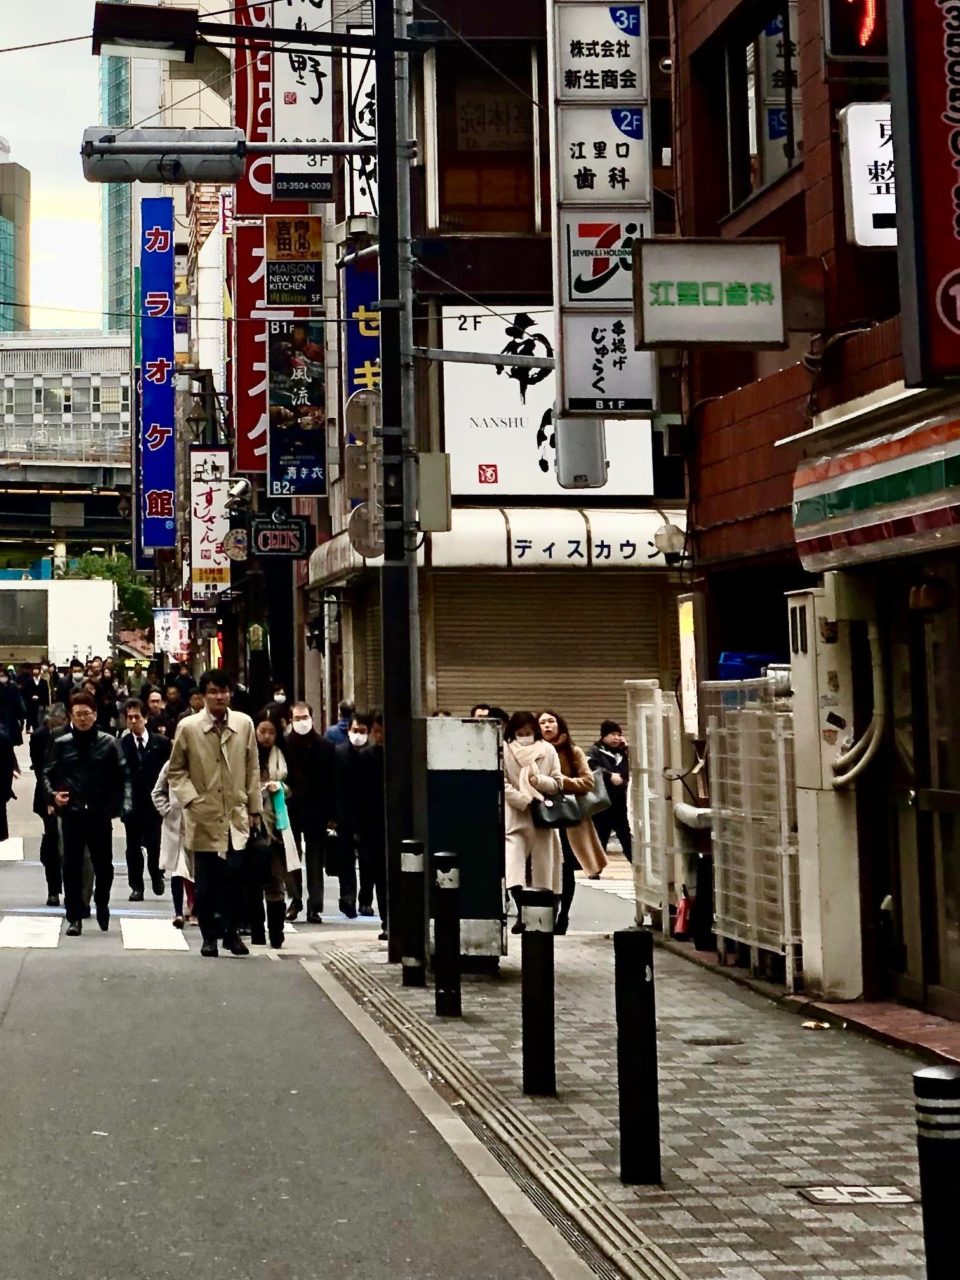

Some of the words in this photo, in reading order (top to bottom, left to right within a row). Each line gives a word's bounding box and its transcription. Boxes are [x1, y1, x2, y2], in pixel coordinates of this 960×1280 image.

[616, 10, 637, 29] 3F
[570, 39, 630, 59] 株式会社
[565, 69, 637, 90] 新生商会
[620, 112, 641, 131] 2F
[569, 141, 630, 160] 江里口
[574, 167, 629, 190] 歯科
[269, 264, 315, 273] MAISON
[649, 281, 775, 306] 江里口歯科
[270, 321, 295, 334] B1F
[458, 315, 481, 331] 2F
[610, 320, 628, 370] 串揚げ
[591, 326, 610, 393] じゅらく
[145, 226, 174, 519] カラオケ館
[290, 367, 312, 405] 風流
[596, 400, 626, 409] B1F
[469, 416, 529, 428] NANSHU
[273, 481, 296, 494] B2F
